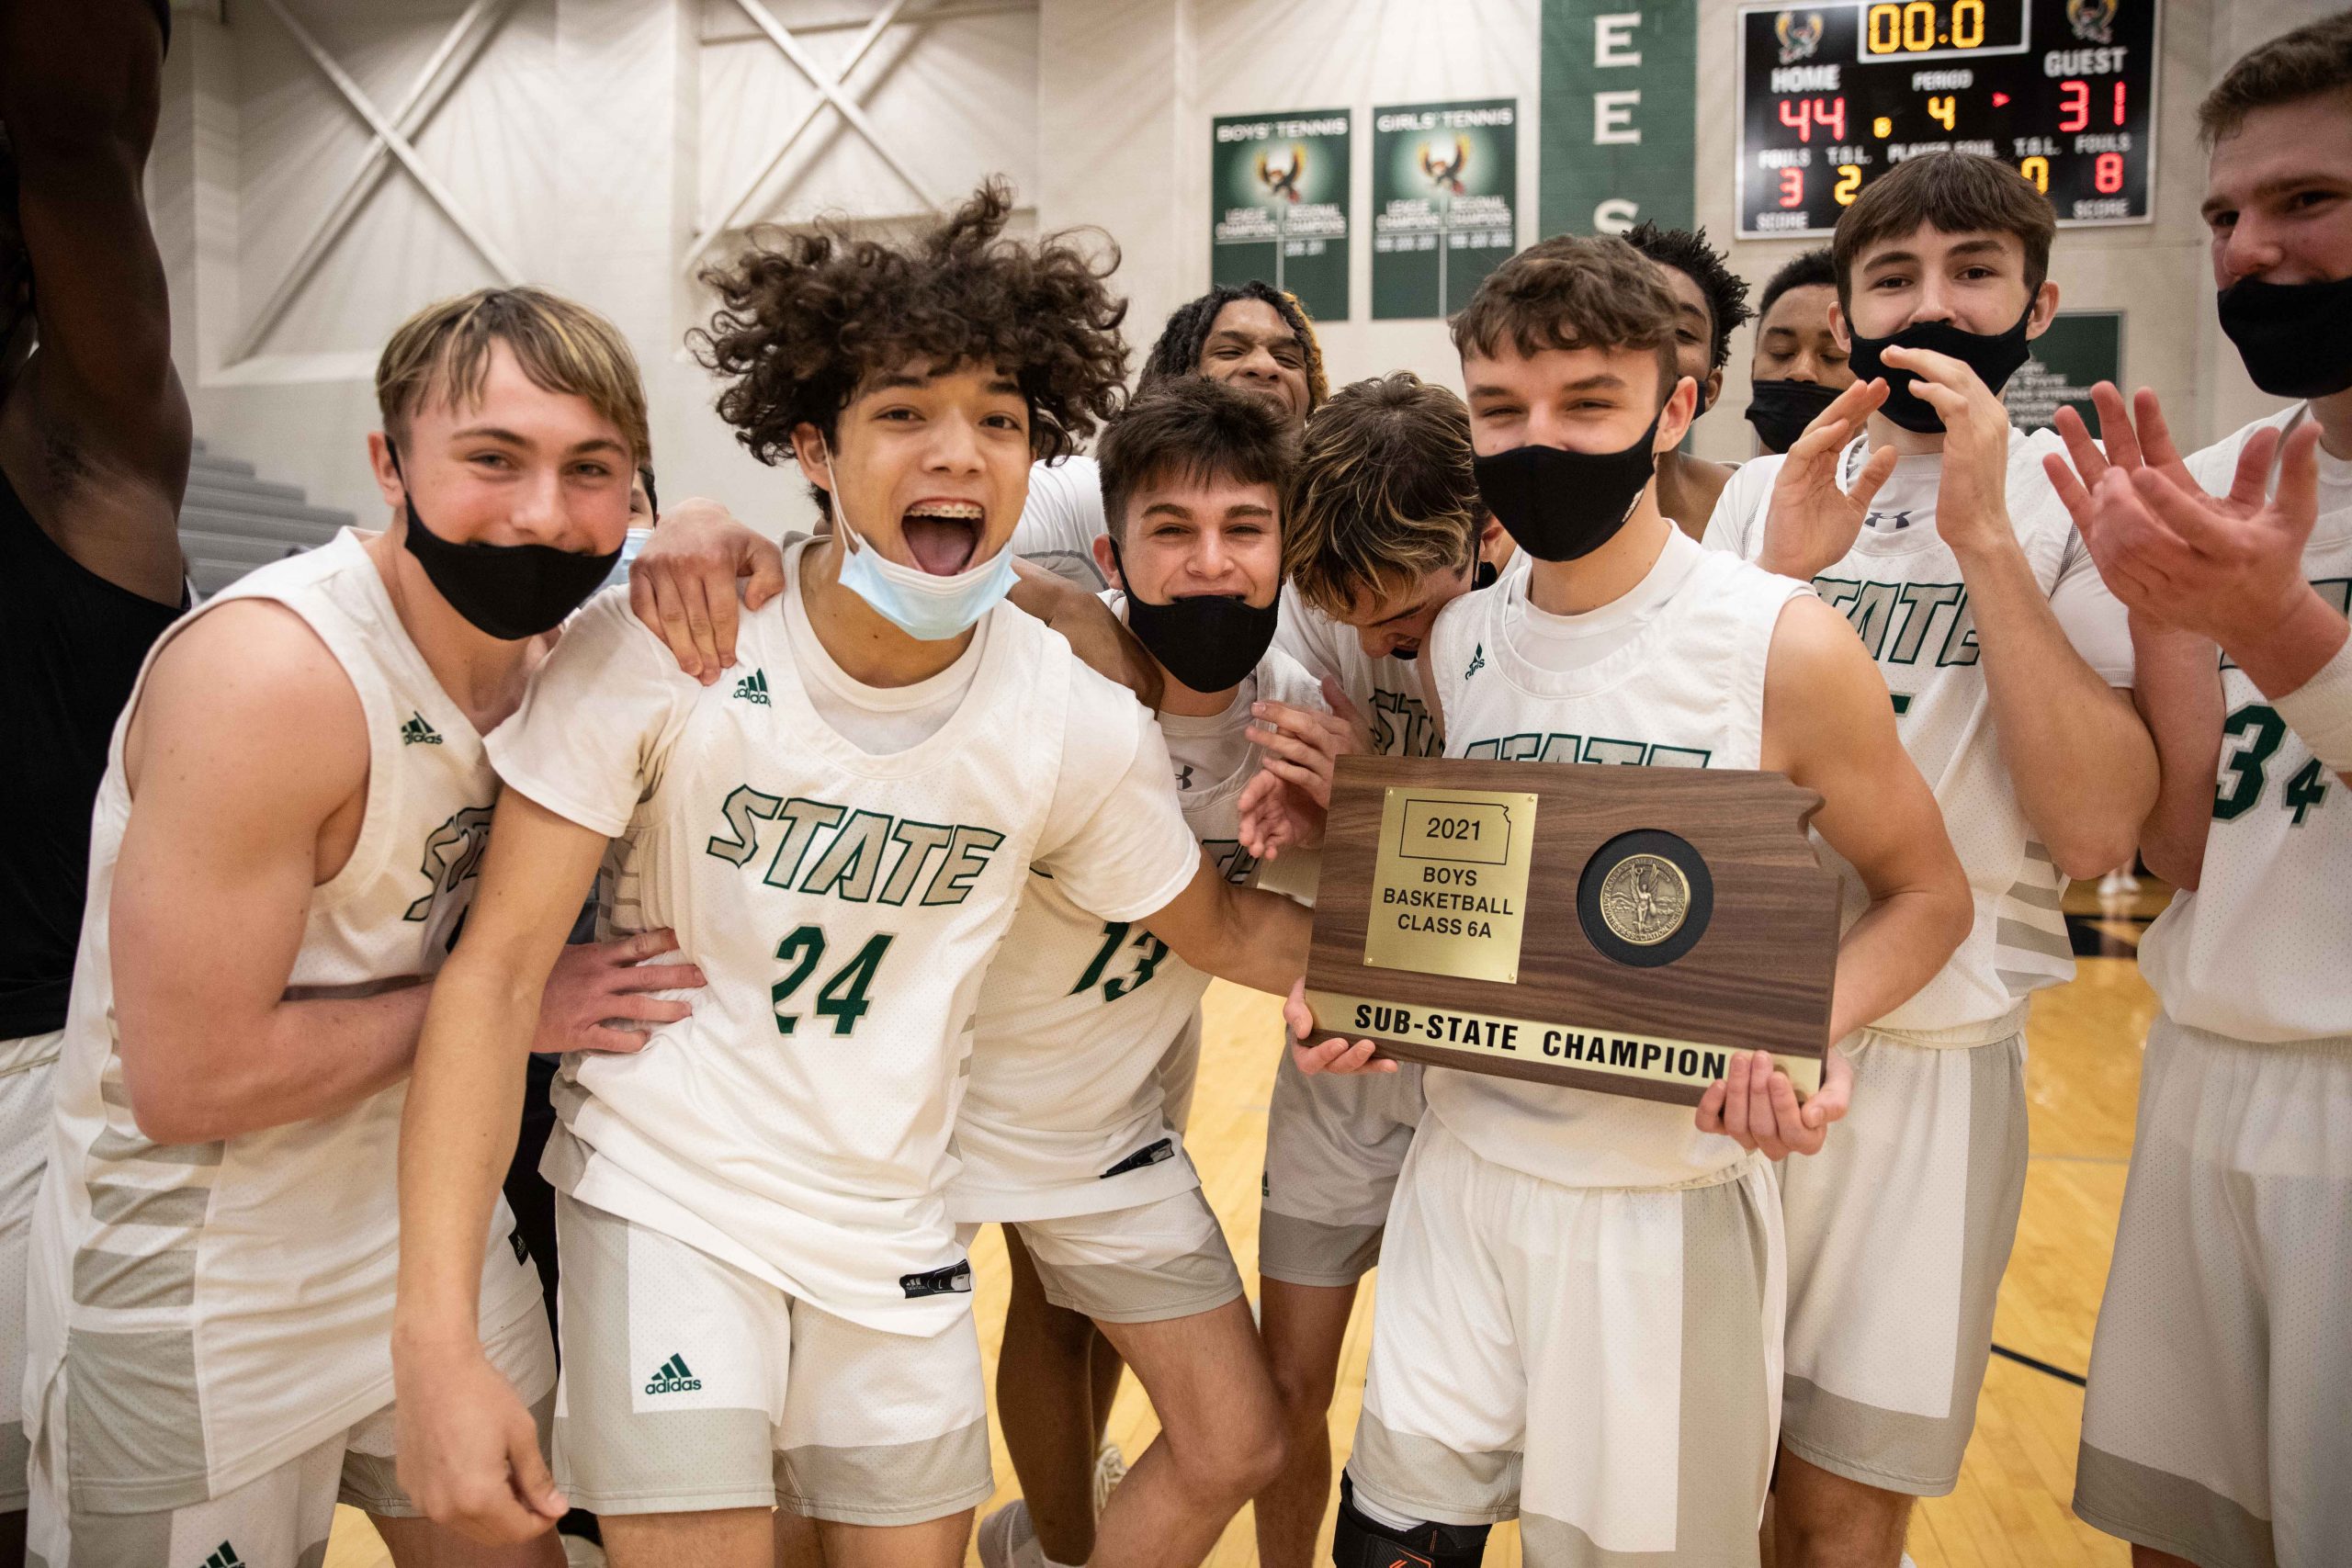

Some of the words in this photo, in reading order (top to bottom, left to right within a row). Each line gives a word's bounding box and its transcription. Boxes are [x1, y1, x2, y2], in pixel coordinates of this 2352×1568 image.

[1868, 0, 1985, 54] 00.0
[1770, 63, 1841, 93] HOME
[2043, 45, 2129, 78] GUEST
[1912, 69, 1973, 92] PERIOD
[1442, 107, 1514, 129] TENNIS
[1779, 97, 1846, 142] 44
[1928, 95, 1956, 131] 4
[2059, 80, 2126, 132] 31
[1276, 117, 1348, 138] TENNIS
[2074, 131, 2132, 154] FOULS
[1758, 147, 1813, 169] FOULS
[2095, 152, 2124, 195] 8
[1779, 166, 1804, 208] 3
[1834, 164, 1861, 207] 2
[706, 784, 1006, 907] STATE
[1426, 817, 1480, 841] 2021
[1423, 866, 1477, 887] BOYS
[1383, 887, 1514, 915] BASKETBALL
[1397, 913, 1463, 936] CLASS
[1467, 920, 1492, 939] 6A
[1064, 920, 1171, 1003] 13
[770, 923, 900, 1038] 24
[1354, 1003, 1519, 1052] SUB-STATE
[1542, 1030, 1725, 1080] CHAMPION
[645, 1377, 702, 1394] adidas
